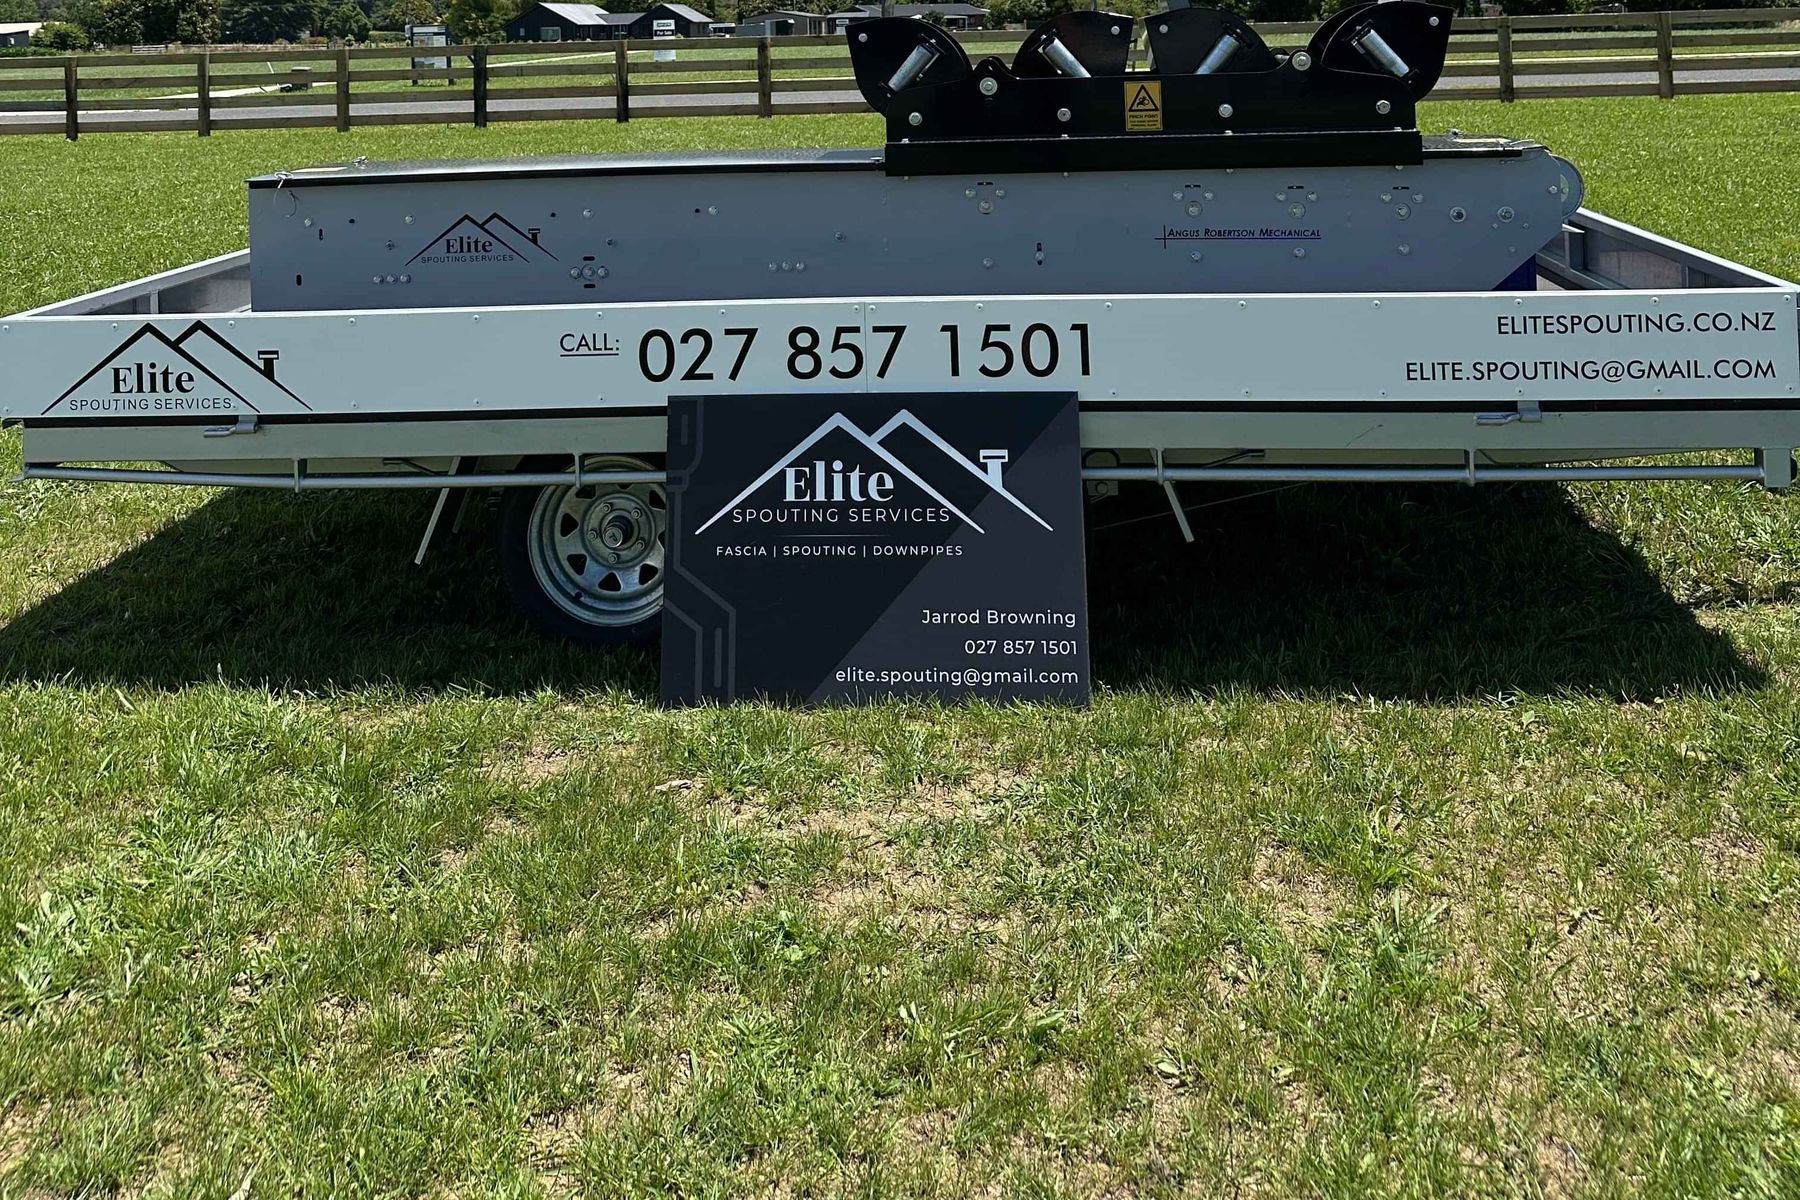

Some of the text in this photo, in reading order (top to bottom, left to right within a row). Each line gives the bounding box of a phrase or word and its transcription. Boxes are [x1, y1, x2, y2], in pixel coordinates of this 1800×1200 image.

[445, 236, 493, 254] Elite
[420, 254, 514, 264] SPOUTING SERVICES
[1497, 311, 1777, 335] ELITESPOUTING.CO.NZ
[559, 323, 1092, 383] CALL: 027 857 1501
[110, 361, 195, 395] Elite
[1406, 359, 1777, 384] ELITE.SPOUTING@GMAIL.COM
[69, 397, 233, 411] SPOUTING SERVICES
[782, 460, 895, 502] Elite
[732, 506, 951, 523] SPOUTING SERVICES
[716, 545, 767, 556] FASCIA
[783, 545, 857, 556] SPOUTING
[873, 545, 963, 556] DOWNPIPES
[921, 609, 1077, 628] Jarrod Browning
[964, 640, 1078, 656] 027 857 1501
[835, 666, 1079, 686] elite.spouting@gmail.com
